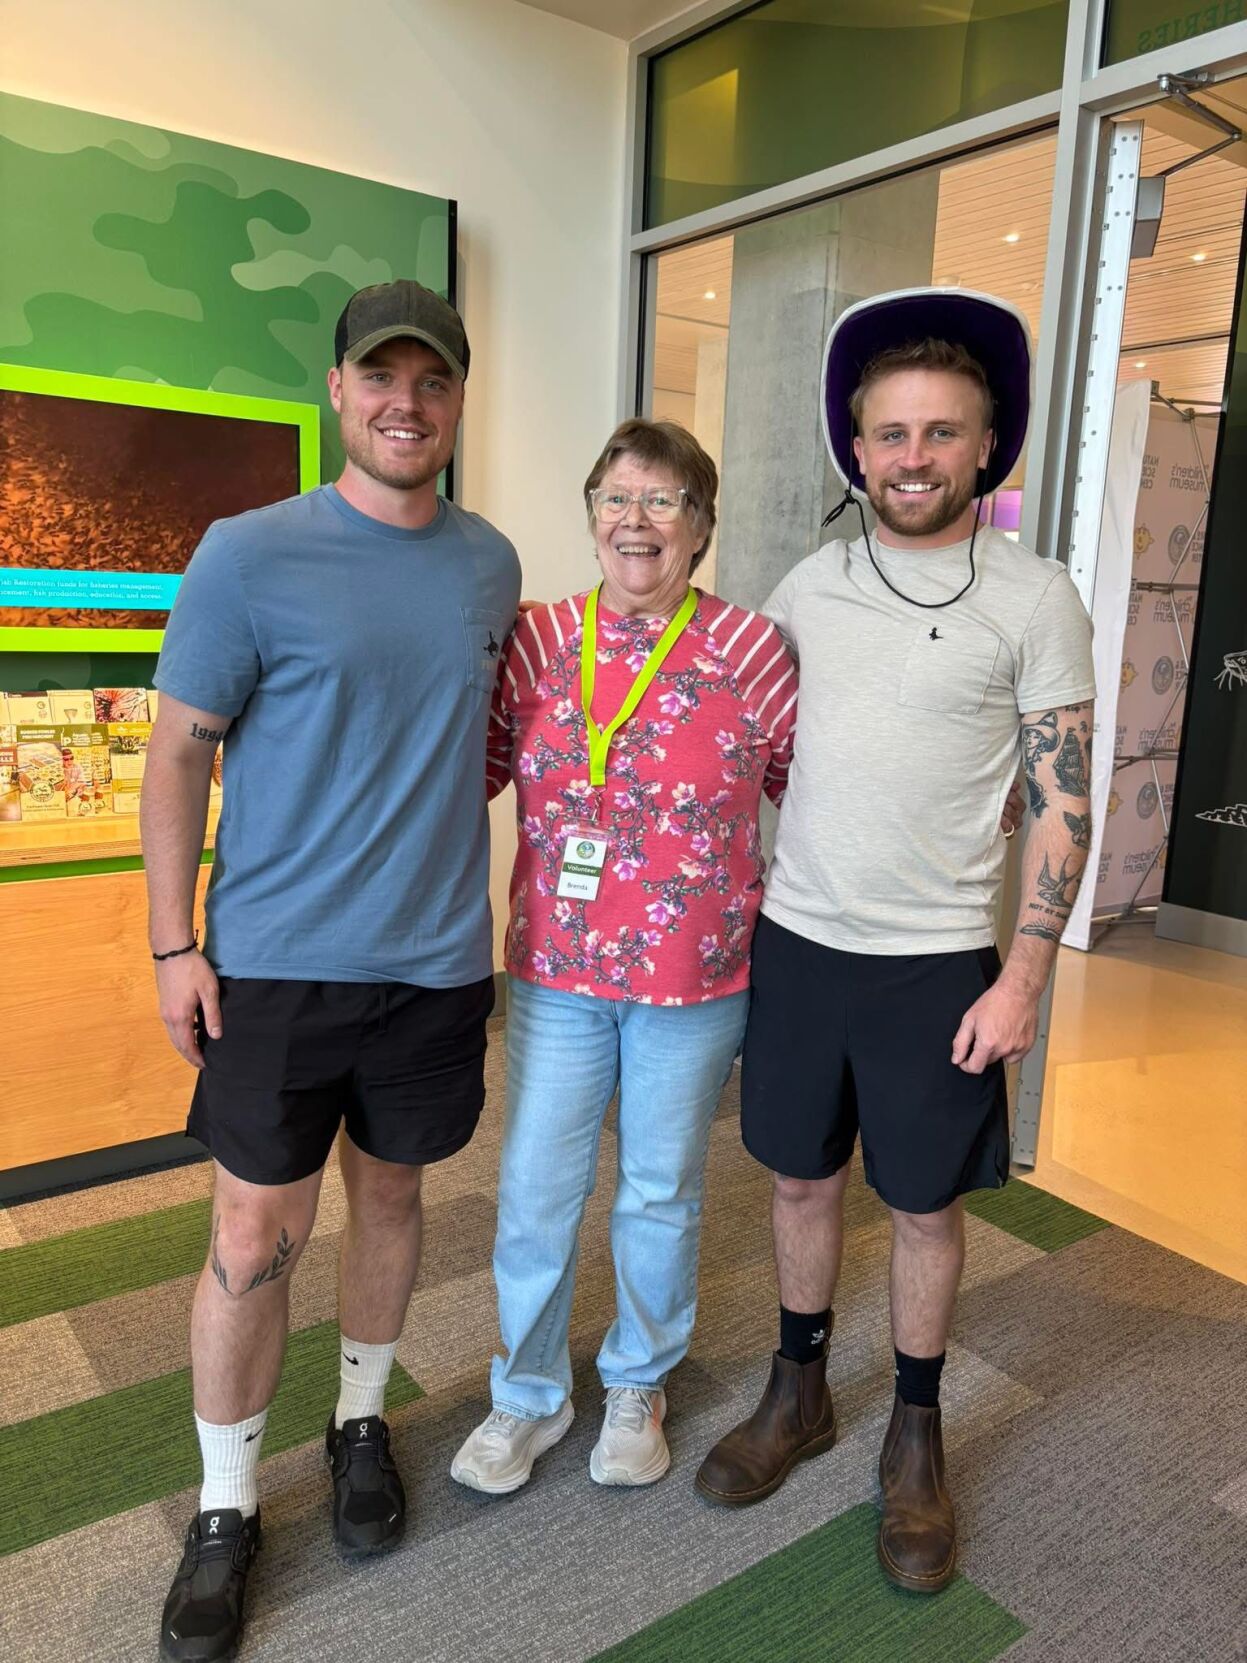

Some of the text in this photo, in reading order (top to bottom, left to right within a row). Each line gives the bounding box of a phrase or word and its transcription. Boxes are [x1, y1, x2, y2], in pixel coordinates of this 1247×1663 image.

[13, 579, 56, 587] Restoration
[57, 580, 77, 589] funds
[33, 589, 46, 597] fish
[567, 864, 597, 874] Volunteer
[567, 882, 588, 891] Brenda
[1028, 902, 1044, 911] NOT
